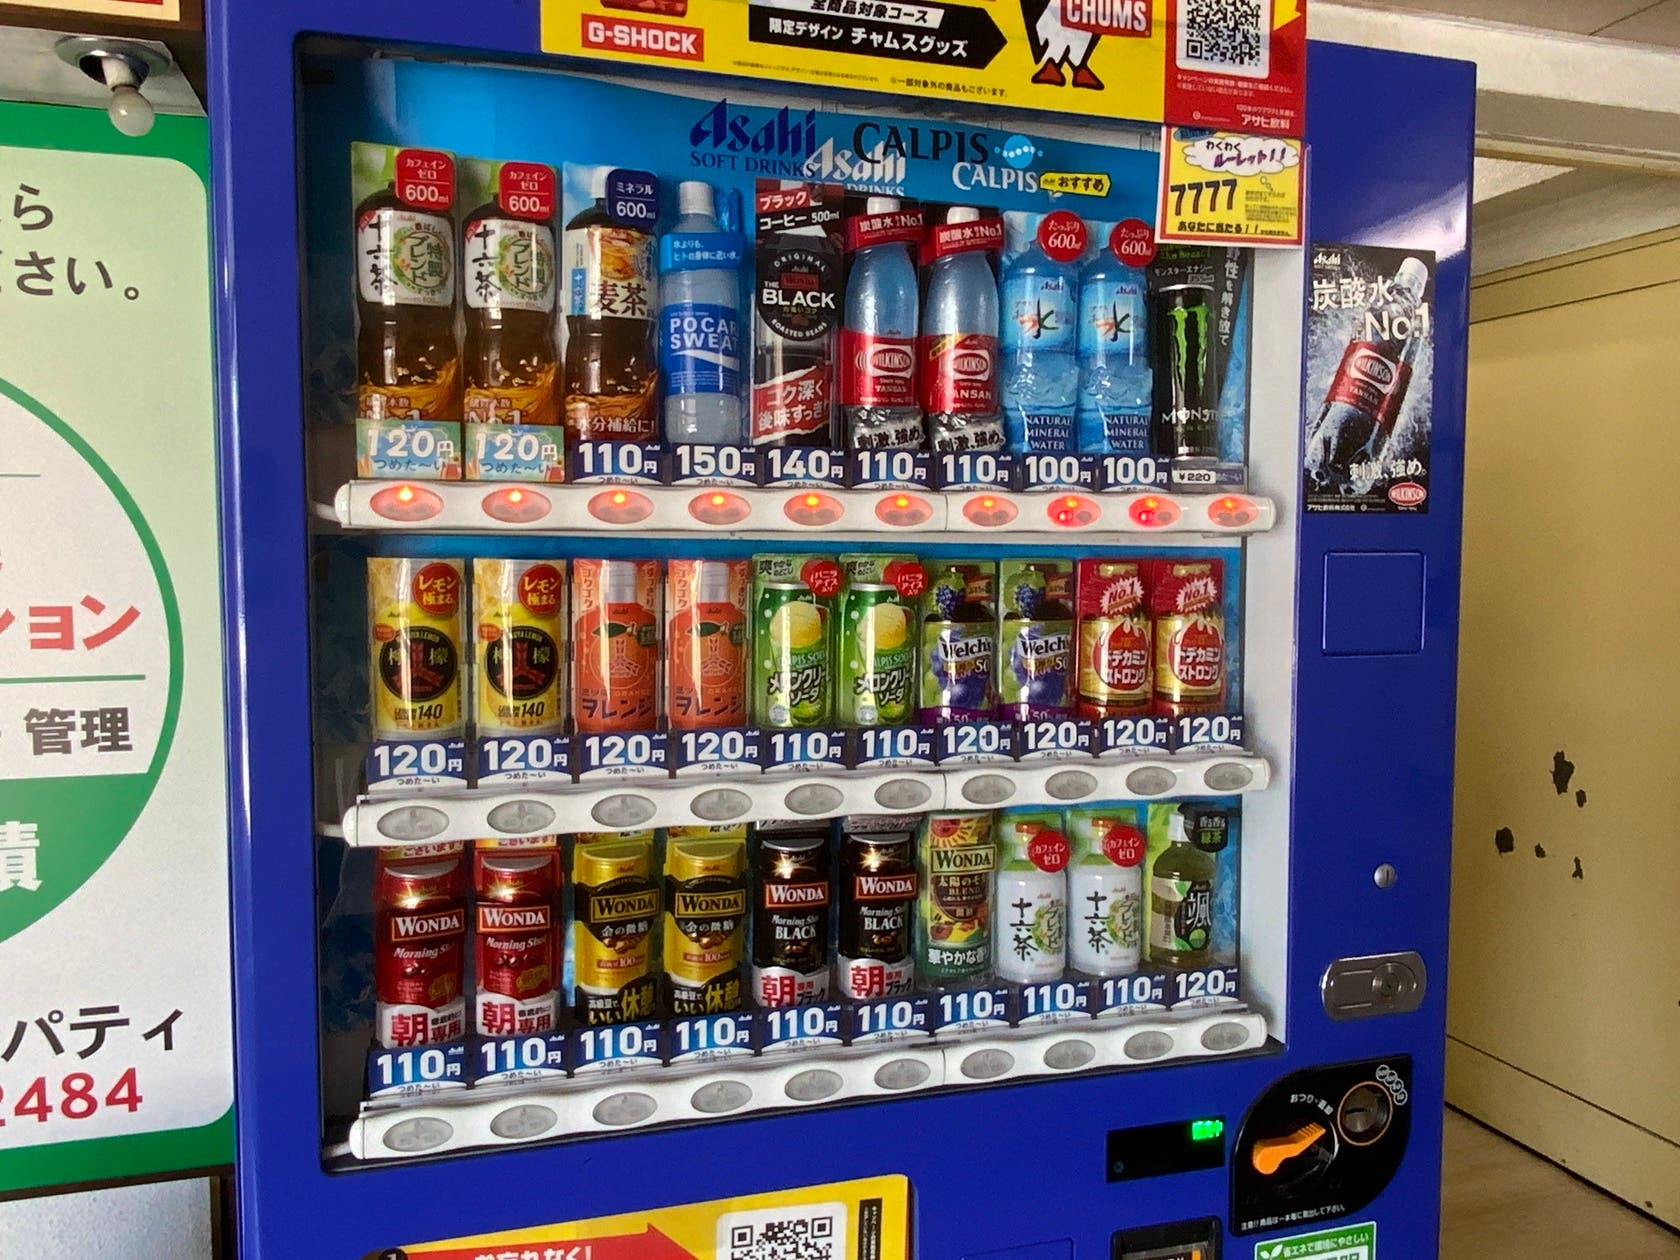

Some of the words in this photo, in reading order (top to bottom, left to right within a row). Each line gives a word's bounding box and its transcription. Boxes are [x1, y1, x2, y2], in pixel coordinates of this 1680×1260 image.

[1065, 0, 1148, 32] CHUMS
[587, 20, 699, 57] G-SHOCK
[768, 17, 844, 41] 限定デザイン
[851, 26, 969, 58] チャムスグッズ
[690, 98, 817, 159] Asahi
[852, 121, 989, 166] CALPIS
[1206, 140, 1241, 152] わくわく
[406, 158, 446, 169] カフェイン
[417, 169, 437, 180] ゼロ
[509, 171, 548, 182] カフェイン
[690, 151, 738, 171] SOFT
[744, 153, 815, 179] DRINKS
[952, 160, 1039, 192] CALPIS
[405, 184, 449, 203] 600ml
[520, 181, 538, 191] ゼロ
[616, 181, 654, 195] ミネラル
[1058, 175, 1104, 192] おすすめ
[509, 196, 550, 213] 600ml
[616, 201, 656, 219] 600ml
[760, 191, 807, 210] ブラック
[1170, 178, 1238, 217] 7777
[760, 213, 807, 230] コーヒー
[859, 217, 893, 232] 炭酸水
[1048, 219, 1080, 232] たっぷり
[1120, 227, 1150, 239] たっぷり
[774, 253, 827, 272] ORIGINAL
[1313, 252, 1341, 265] Asahi
[764, 280, 780, 289] THE
[1312, 275, 1393, 311] 炭酸水
[599, 280, 647, 317] 麦茶
[762, 289, 836, 309] BLACK
[771, 318, 804, 338] ROASTED
[1365, 302, 1430, 342] No.1
[767, 379, 823, 406] コク深く
[367, 429, 454, 458] 120円
[476, 432, 558, 461] 120円
[1032, 441, 1065, 450] WATER
[1111, 439, 1145, 449] WATER
[578, 442, 658, 474] 110円
[676, 445, 755, 476] 150円
[768, 449, 843, 478] 140円
[858, 452, 926, 480] 110円
[942, 455, 1009, 482] 110円
[1025, 456, 1091, 483] 100円
[1103, 457, 1168, 484] 100円
[1349, 459, 1427, 481] 刺激、強め。
[419, 575, 458, 592] レモン
[524, 576, 560, 592] レモン
[583, 568, 594, 609] ゴクゴク
[676, 568, 686, 608] ゴクゴク
[1109, 577, 1136, 601] No.1
[1184, 577, 1211, 600] No.1
[418, 703, 443, 720] 140
[521, 702, 545, 718] 140
[24, 707, 133, 756] 管理
[943, 725, 1011, 754] 120円
[1024, 721, 1089, 750] 120円
[1103, 718, 1166, 746] 120円
[1179, 716, 1241, 743] 120円
[483, 738, 567, 771] 120円
[586, 734, 665, 767] 120円
[682, 731, 758, 761] 120円
[771, 732, 841, 761] 110円
[862, 729, 930, 758] 110円
[374, 744, 463, 777] 120円
[1035, 843, 1065, 854] カフェイン
[1109, 837, 1140, 849] カフェイン
[1118, 849, 1136, 859] ゼロ
[936, 850, 991, 868] WONDA
[1044, 855, 1061, 865] ゼロ
[770, 885, 824, 903] WONDA
[860, 876, 913, 894] WONDA
[483, 907, 546, 927] WONDA
[595, 898, 655, 916] WONDA
[681, 896, 740, 913] WONDA
[860, 906, 893, 918] Morning
[395, 915, 460, 937] WONDA
[772, 915, 806, 926] Morning
[775, 925, 817, 940] BLACK
[864, 916, 903, 930] BLACK
[1010, 898, 1039, 961] 十六茶
[1084, 891, 1113, 953] 十六茶
[394, 946, 438, 959] Morning
[486, 936, 525, 950] Morning
[761, 975, 795, 1008] 朝
[851, 965, 885, 998] 朝
[1102, 976, 1163, 1006] 110円
[1175, 970, 1236, 999] 120円
[939, 991, 1005, 1021] 110円
[1023, 983, 1087, 1013] 110円
[391, 1012, 428, 1046] 朝
[482, 1002, 516, 1035] 朝
[767, 1006, 838, 1040] 110円
[857, 1001, 925, 1032] 110円
[580, 1025, 657, 1060] 110円
[676, 1016, 749, 1050] 110円
[377, 1049, 461, 1085] 110円
[481, 1037, 561, 1072] 110円
